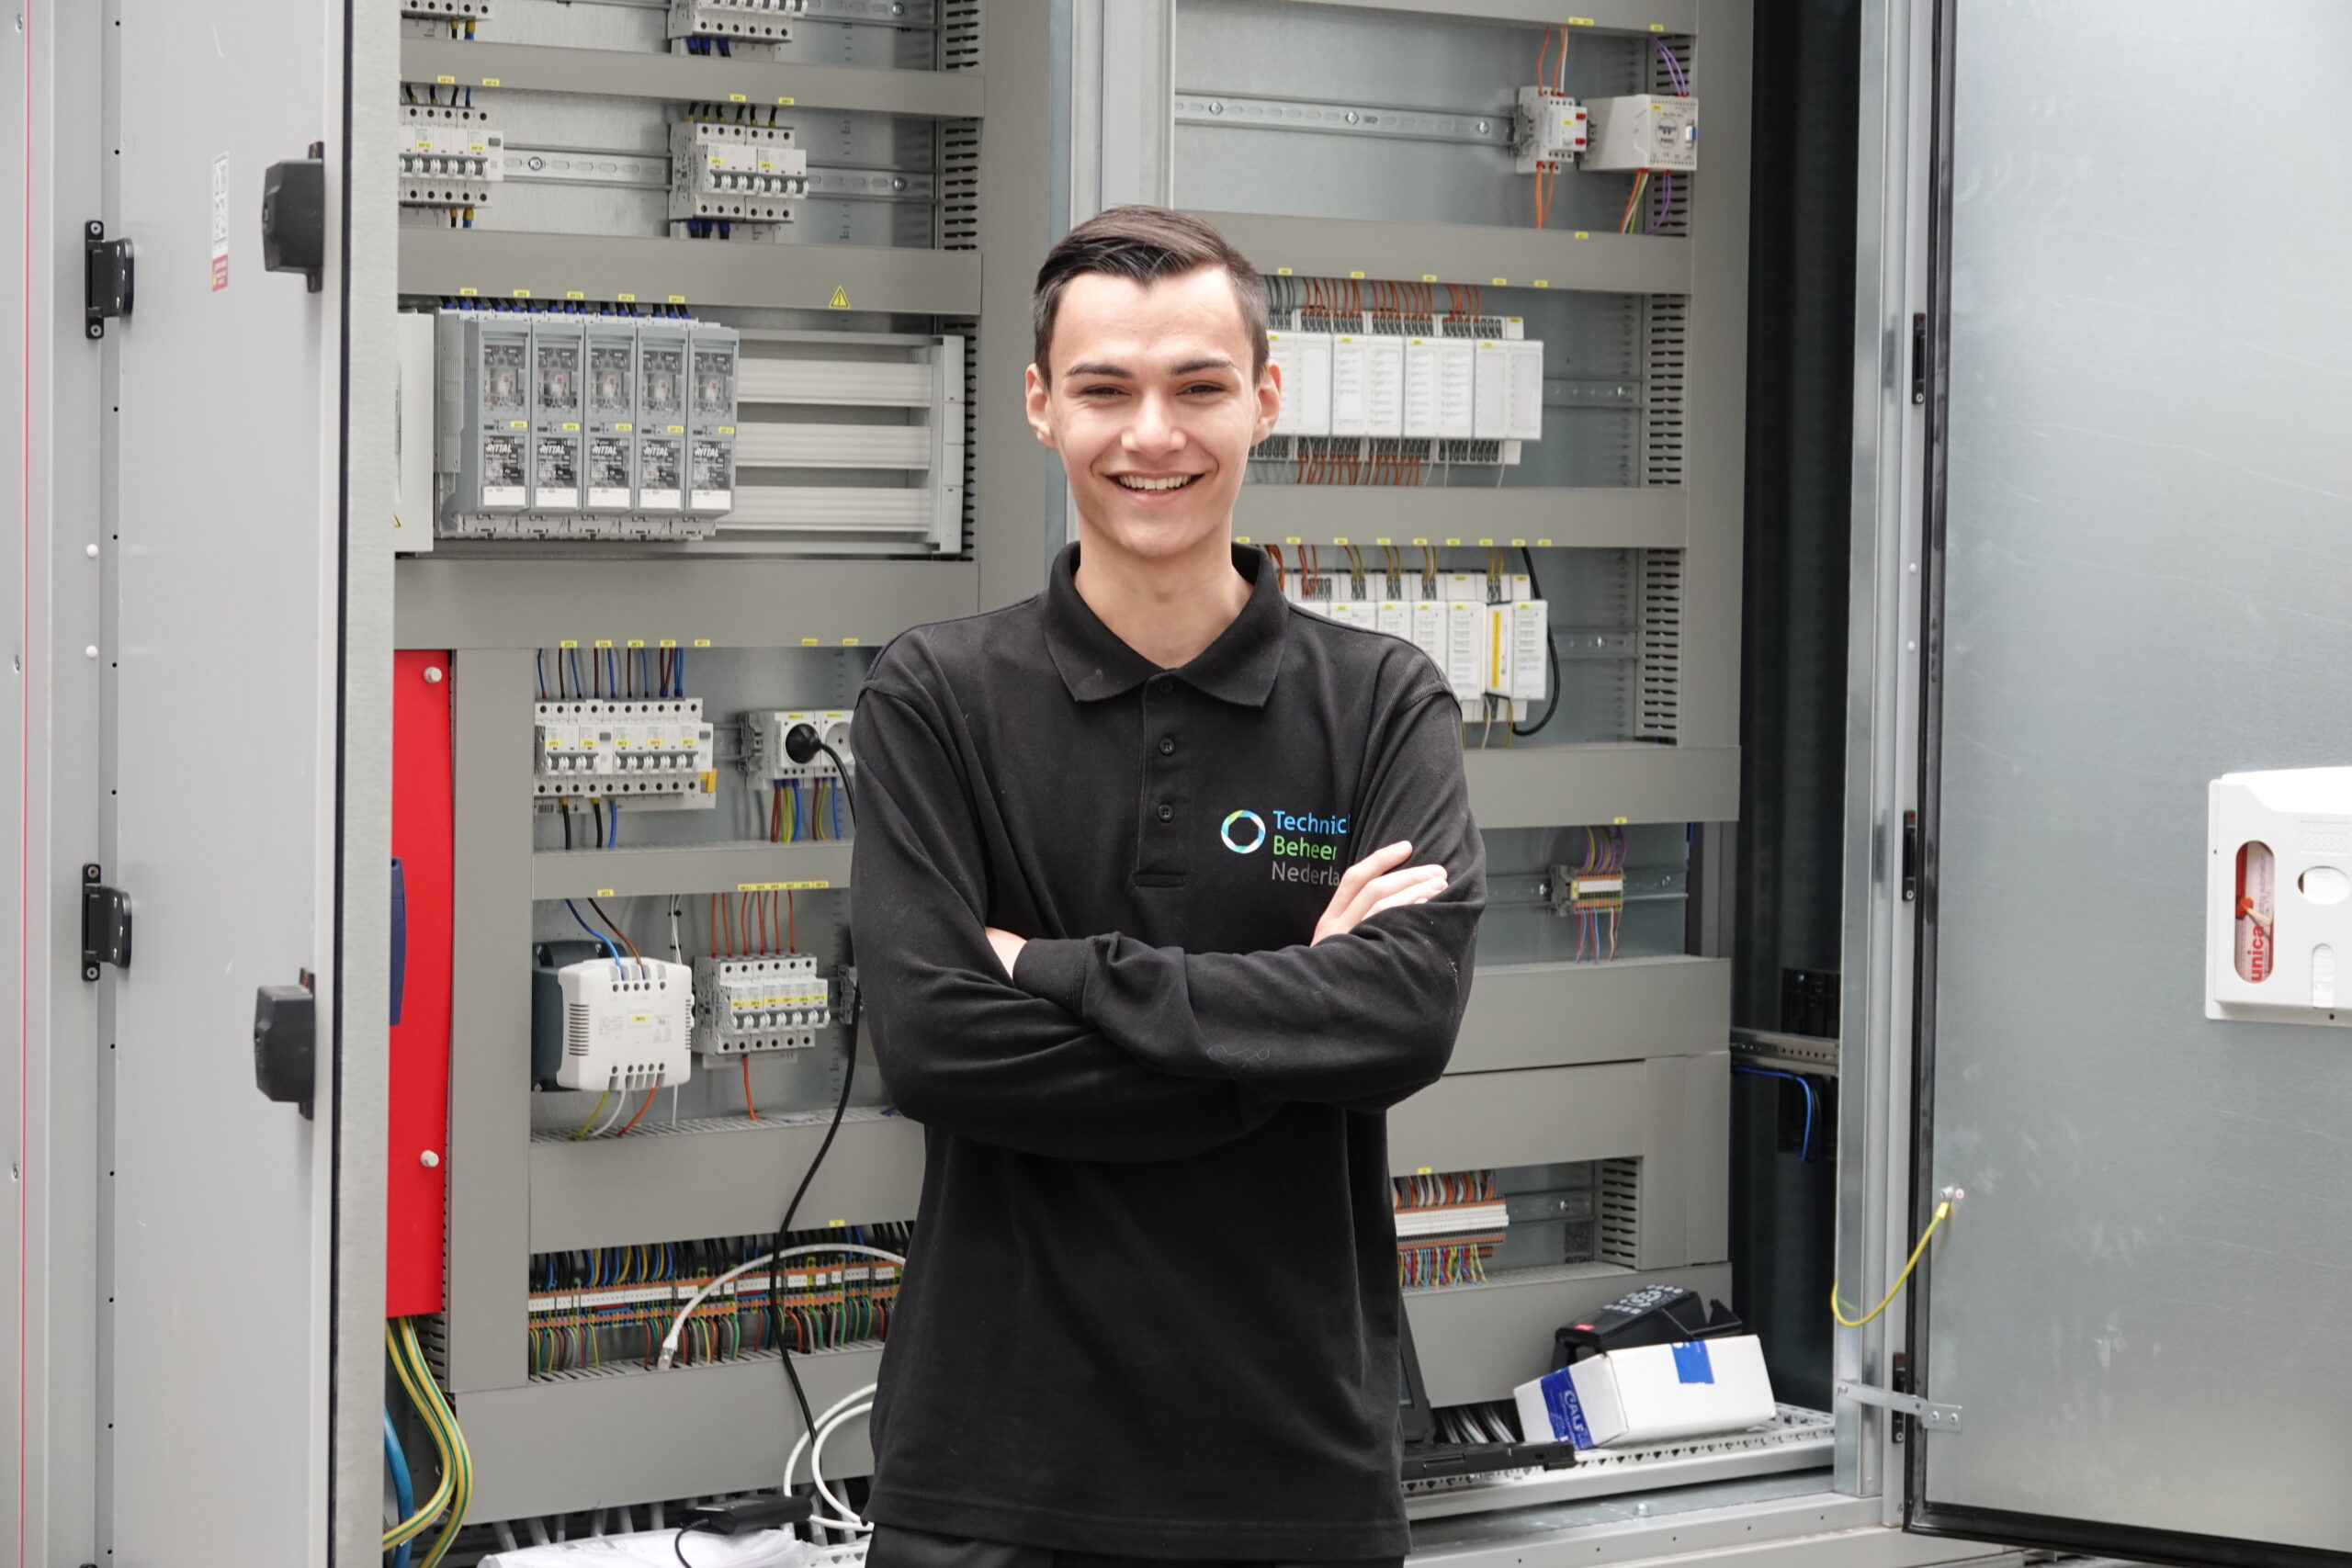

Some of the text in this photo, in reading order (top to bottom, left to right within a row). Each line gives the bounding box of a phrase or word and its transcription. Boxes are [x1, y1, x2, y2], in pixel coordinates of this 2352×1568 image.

[1272, 810, 1350, 835] Technic
[1273, 834, 1337, 861] Beheer
[1272, 860, 1340, 886] Nederla
[2247, 926, 2264, 982] unica
